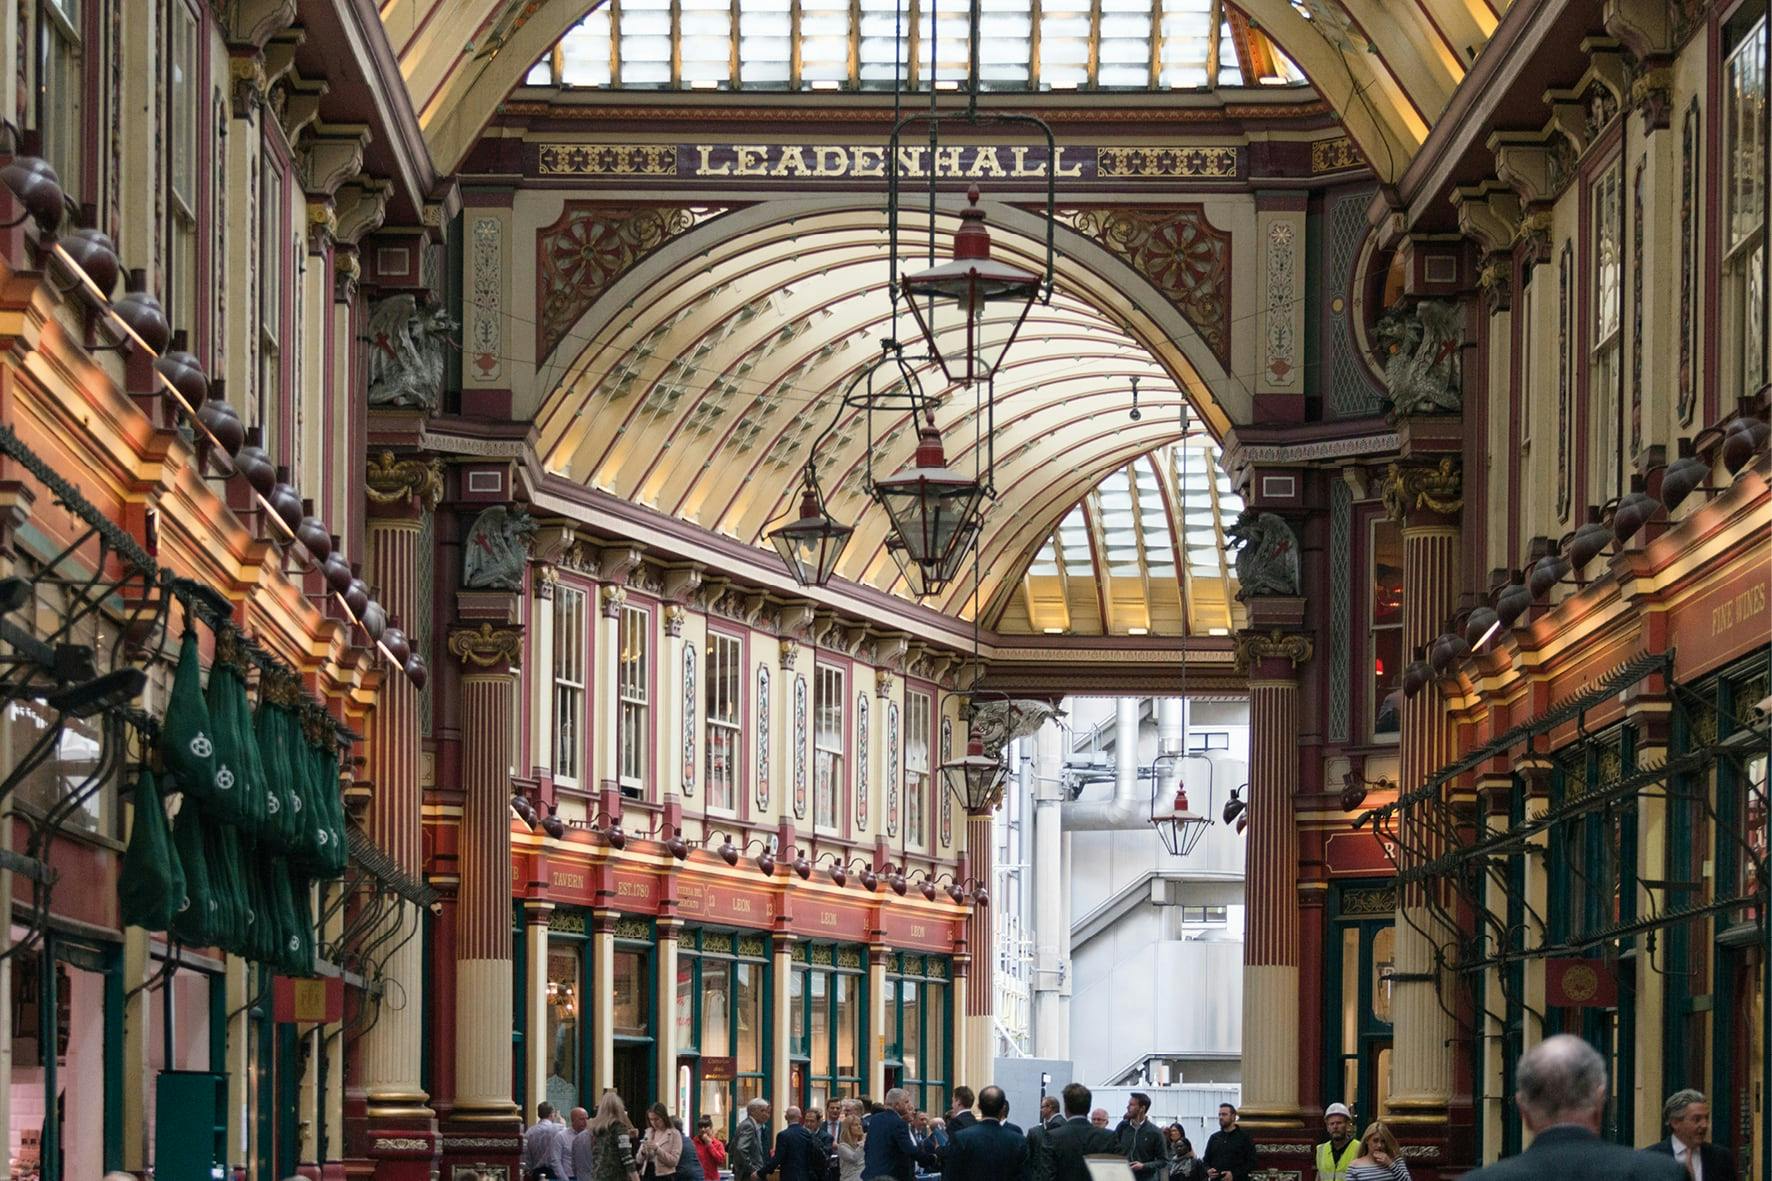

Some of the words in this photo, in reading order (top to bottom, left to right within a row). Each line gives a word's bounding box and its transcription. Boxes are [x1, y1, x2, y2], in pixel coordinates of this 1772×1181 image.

[696, 144, 1082, 177] LEADENHALL
[1711, 599, 1734, 637] FINE
[1735, 582, 1766, 624] WINES
[552, 871, 584, 889] TAVERN
[732, 897, 751, 913] LEON
[820, 911, 838, 926] LEON
[910, 925, 926, 938] LEON
